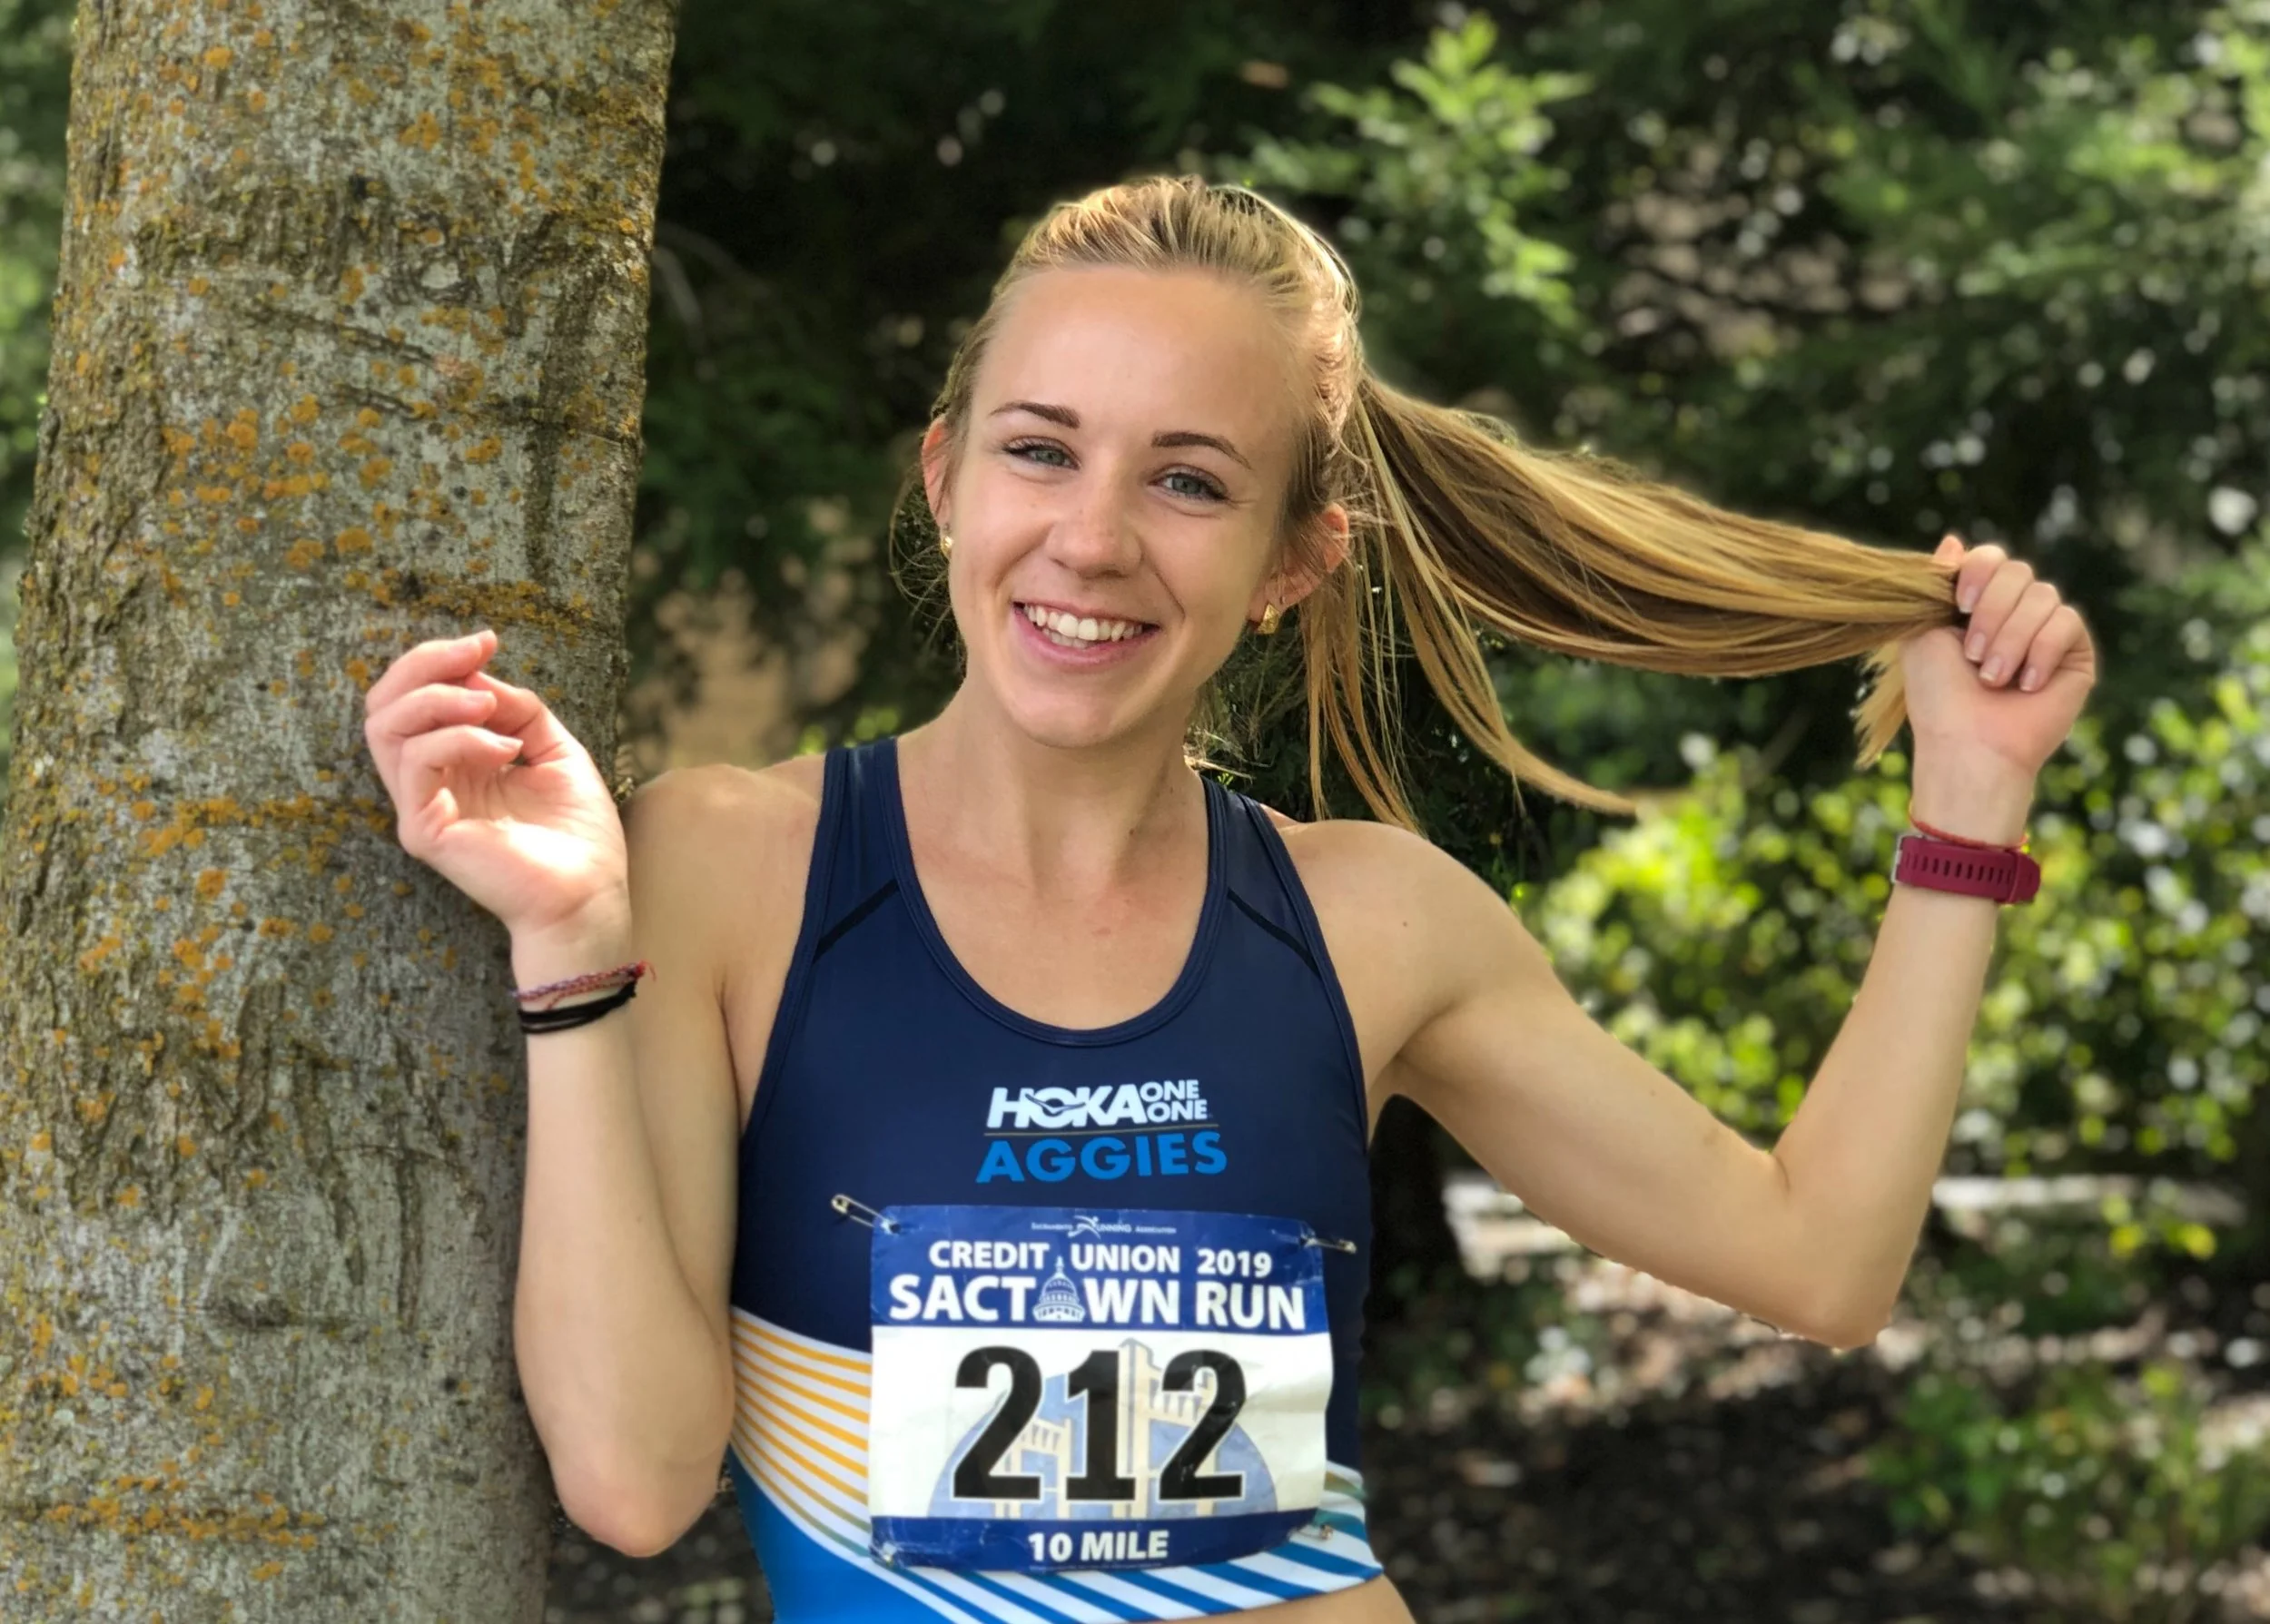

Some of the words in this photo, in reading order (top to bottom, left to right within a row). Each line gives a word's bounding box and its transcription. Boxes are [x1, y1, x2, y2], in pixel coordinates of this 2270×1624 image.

[986, 1084, 1149, 1128] HOKA
[1140, 1079, 1199, 1103] ONE
[1147, 1098, 1209, 1123] ONE
[975, 1131, 1228, 1183] AGGIES
[929, 1241, 1051, 1270] CREDIT
[1070, 1245, 1180, 1273] UNION
[1196, 1248, 1272, 1278] 2019
[1196, 1281, 1306, 1330] RUN
[953, 1345, 1248, 1501] 212
[1028, 1533, 1072, 1561] 10
[1081, 1530, 1170, 1561] MILE
